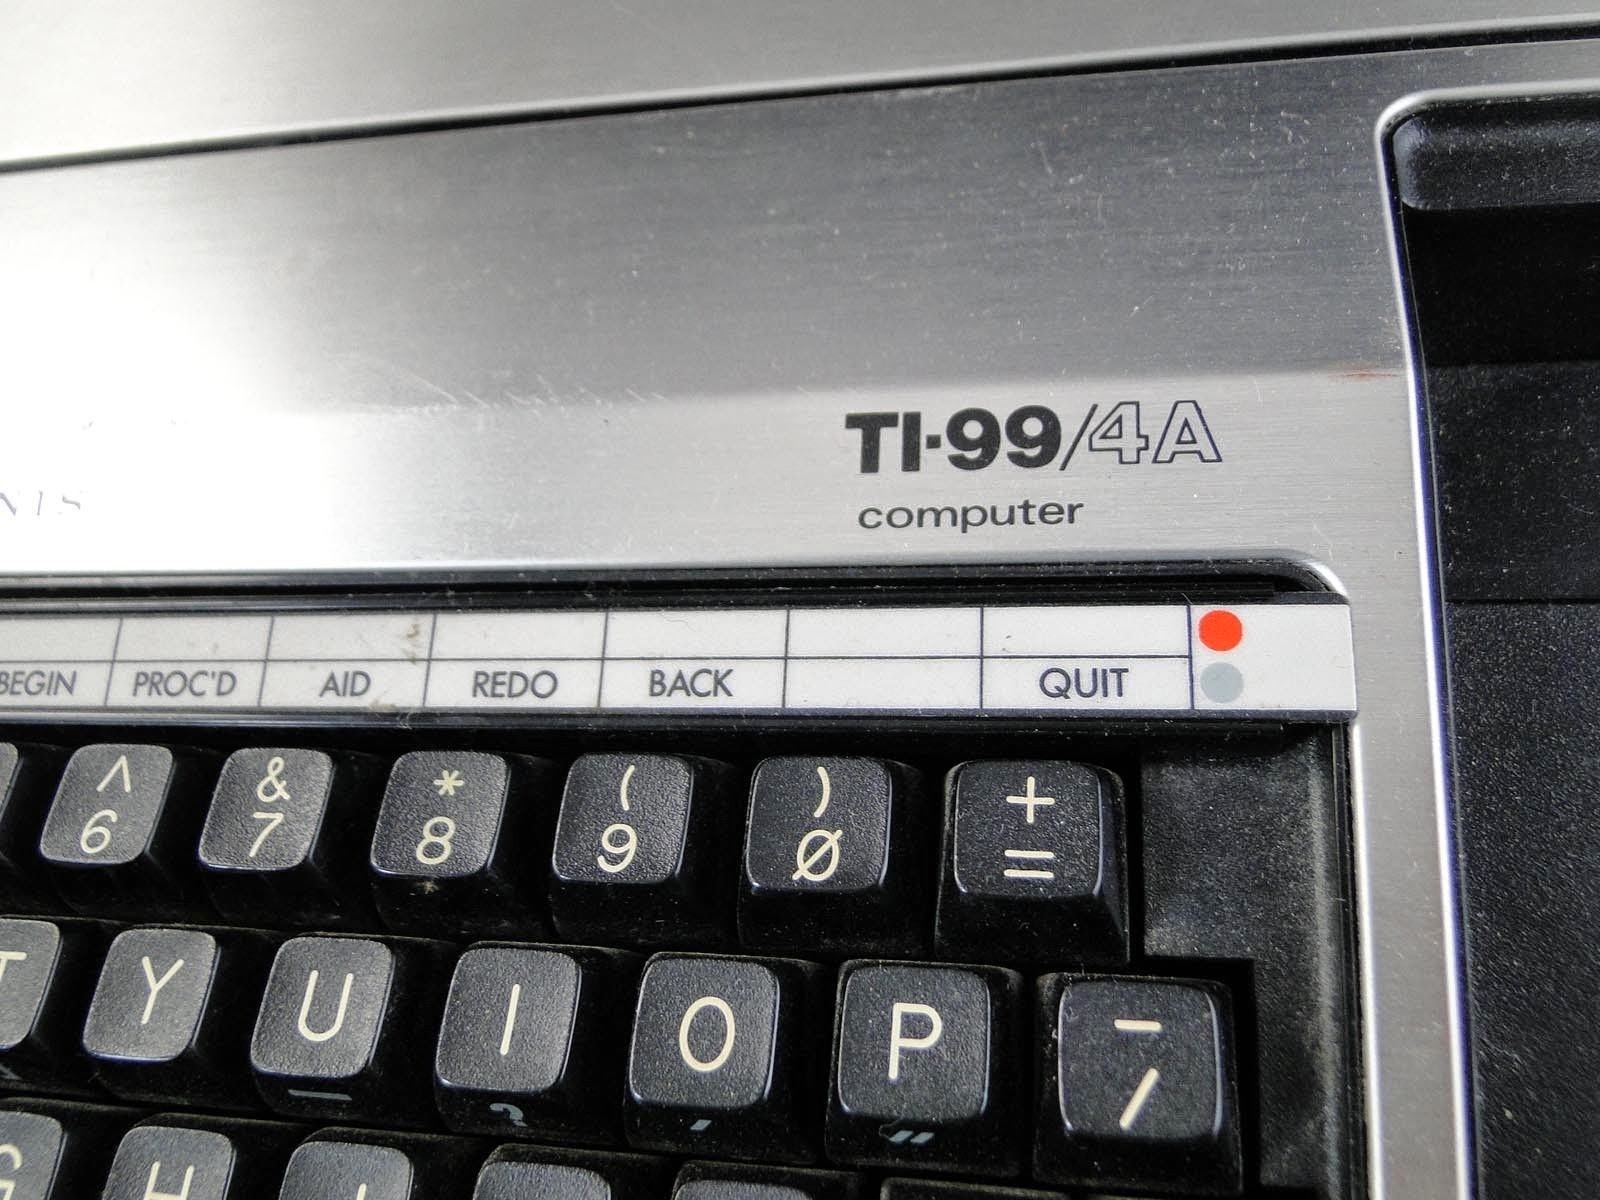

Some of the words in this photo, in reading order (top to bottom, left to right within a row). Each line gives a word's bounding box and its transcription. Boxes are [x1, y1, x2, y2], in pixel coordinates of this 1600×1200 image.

[845, 400, 1223, 474] TI-99/4A
[858, 500, 1084, 534] computer
[0, 670, 77, 697] BEGIN
[132, 669, 238, 698] PROC'D
[319, 670, 372, 698] AID
[471, 669, 559, 700] REDO
[648, 669, 734, 699] BACK
[1039, 667, 1130, 700] QUIT
[256, 756, 292, 803] &
[619, 764, 637, 812] (
[813, 766, 831, 818] )
[1005, 776, 1056, 824] +
[79, 810, 119, 854] 6
[249, 811, 284, 858] 7
[414, 816, 456, 866] 8
[596, 823, 638, 874] 9
[1003, 850, 1056, 880] =
[141, 955, 185, 1025] Y
[298, 969, 355, 1043] U
[678, 996, 736, 1074] O
[887, 1002, 943, 1081] P
